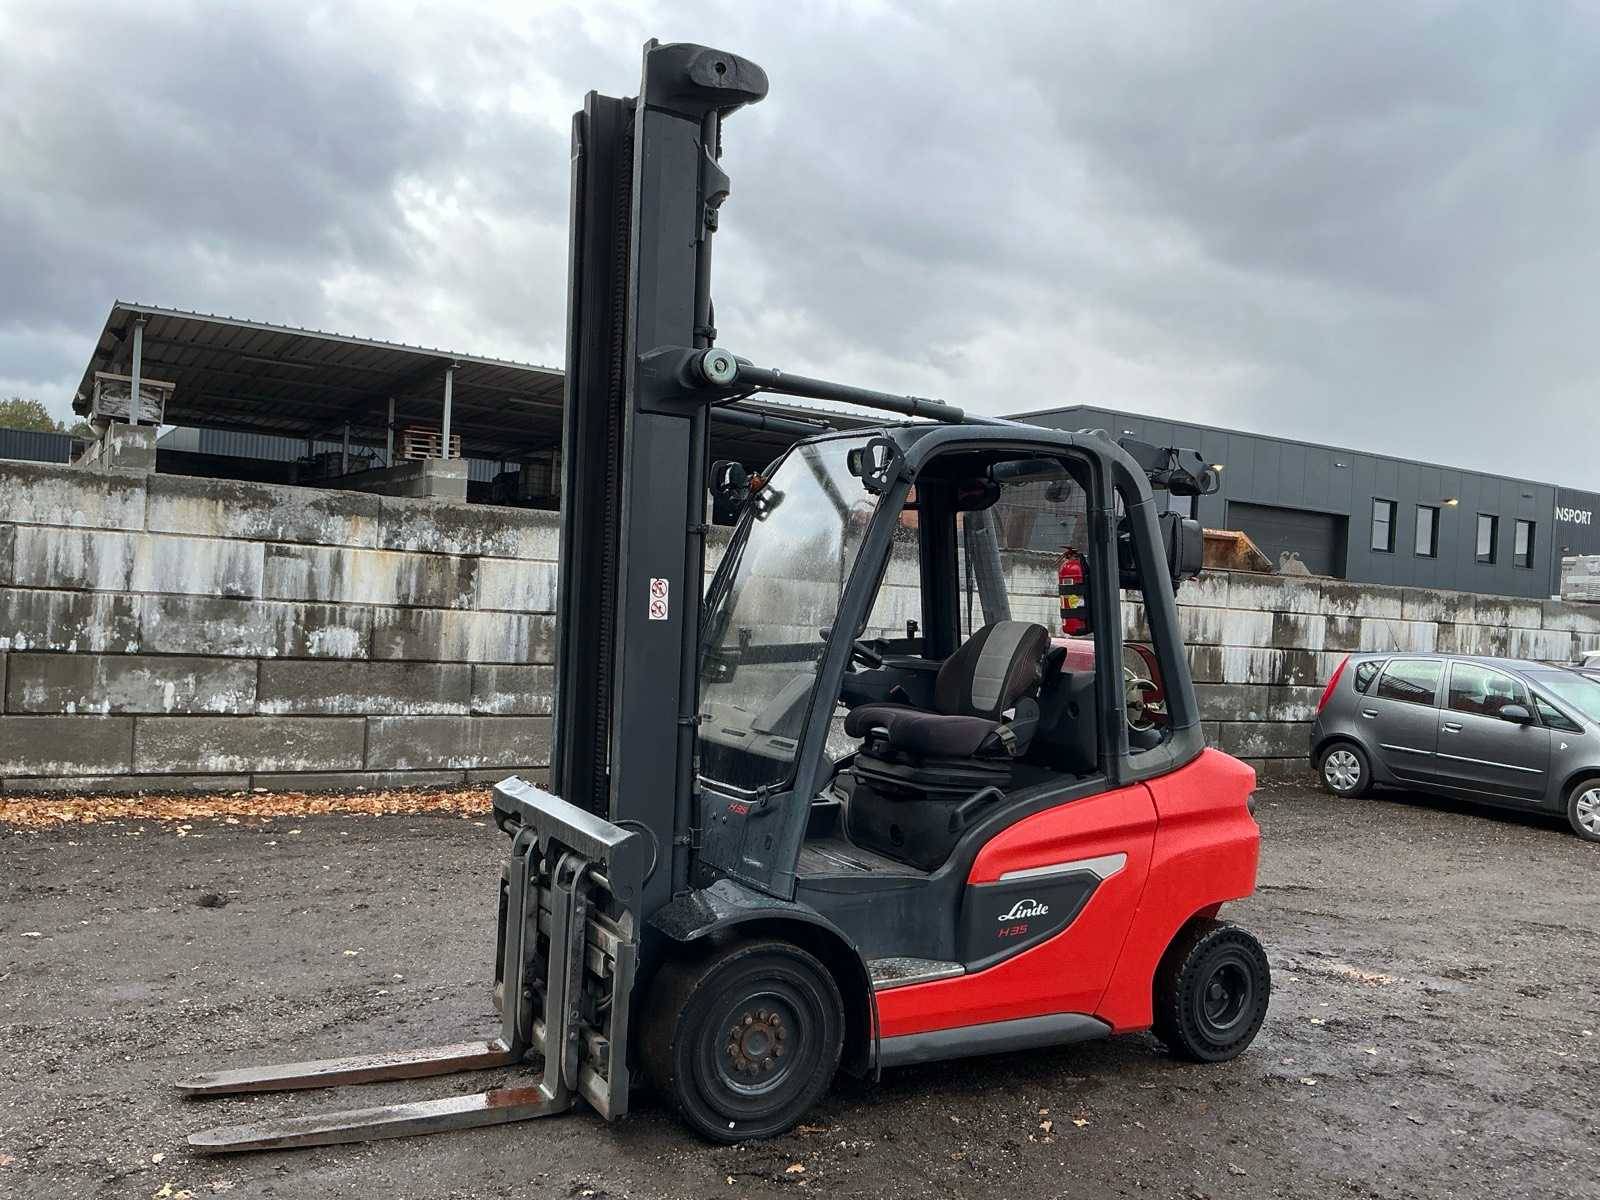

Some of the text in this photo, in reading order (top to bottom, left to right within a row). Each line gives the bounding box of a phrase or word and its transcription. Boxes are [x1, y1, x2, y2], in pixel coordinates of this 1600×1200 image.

[1555, 506, 1592, 525] NSPORT
[998, 899, 1049, 921] Linde
[998, 925, 1028, 937] H35
